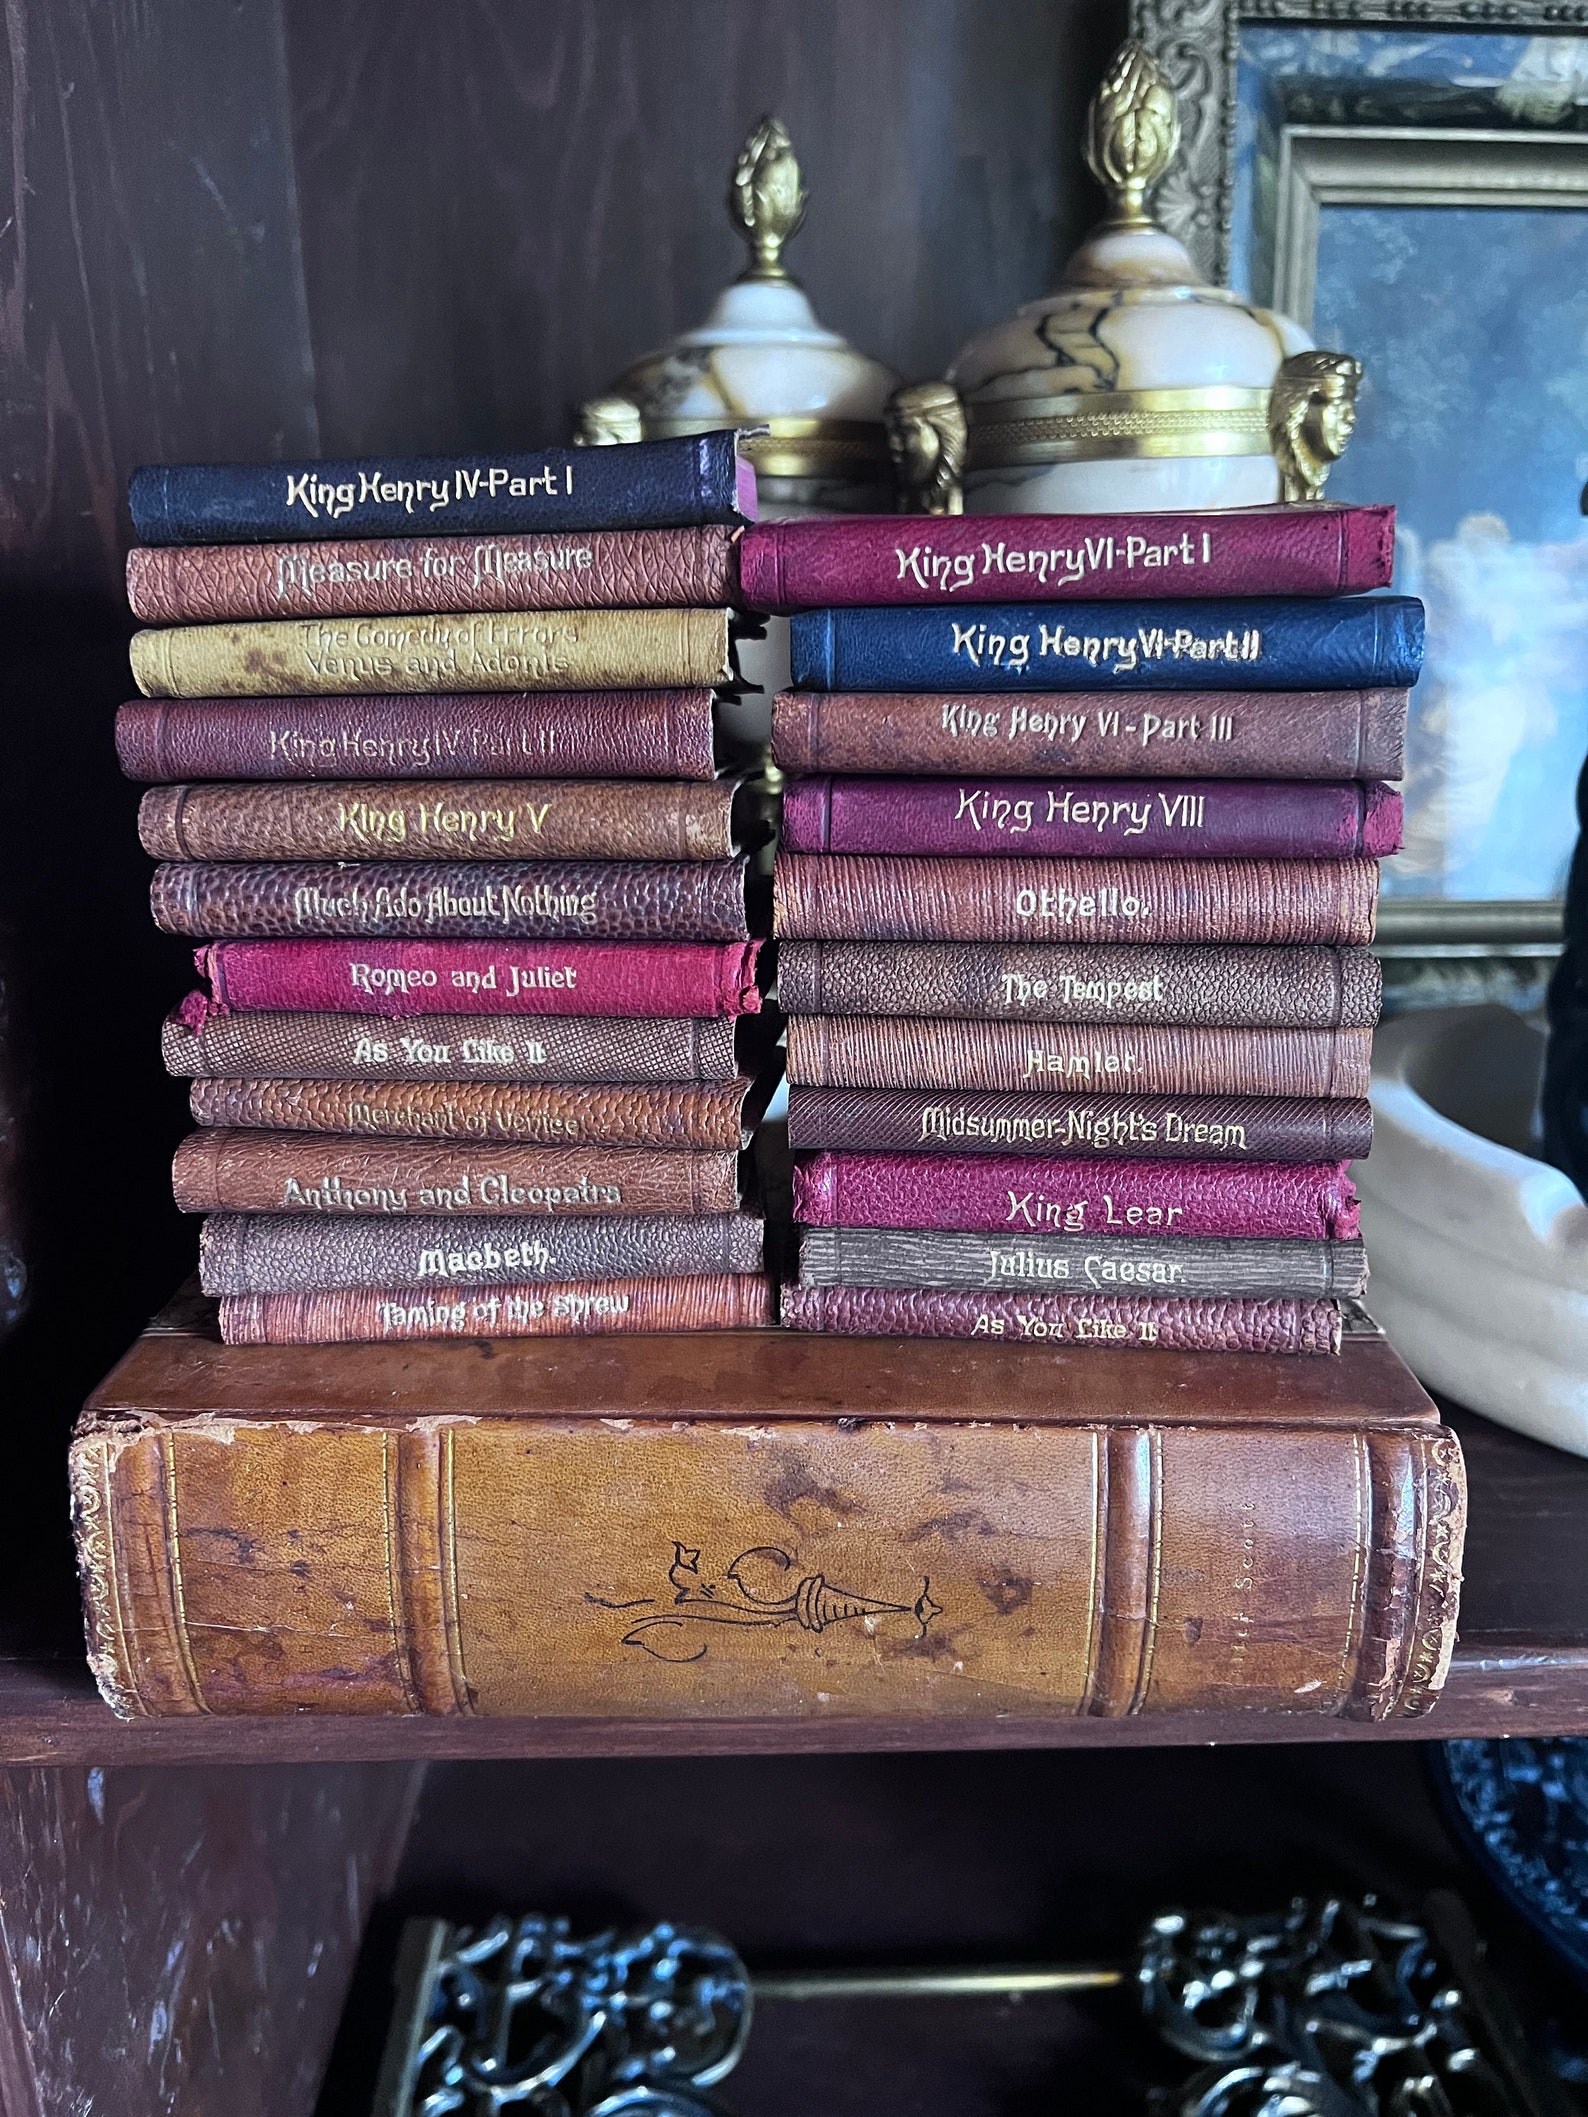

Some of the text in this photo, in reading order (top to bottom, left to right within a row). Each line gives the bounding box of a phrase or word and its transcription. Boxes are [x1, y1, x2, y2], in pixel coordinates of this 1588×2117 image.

[286, 473, 355, 519] King
[357, 472, 450, 514] Henry
[276, 544, 594, 602] Measure for Measure
[896, 546, 975, 593] King
[981, 542, 1086, 587] Henry
[300, 624, 350, 654] The
[354, 622, 452, 650] Comedy
[457, 620, 484, 647] of
[951, 623, 1031, 666] King
[1039, 624, 1140, 675] Henry
[304, 650, 395, 681] Venus
[404, 649, 457, 679] and
[941, 704, 1000, 737] King
[1008, 705, 1088, 742] Henry
[1098, 710, 1121, 738] VI
[1142, 712, 1201, 747] Part
[1210, 716, 1235, 741] III
[270, 729, 337, 777] King
[341, 726, 432, 767] Henry
[435, 729, 461, 756] IV
[337, 802, 552, 843] King Henry V
[955, 788, 1205, 836] King Henry VIII
[294, 884, 599, 926] Much Ado About Nothing
[349, 962, 578, 997] Romeo and Juliet
[1001, 973, 1164, 1009] The Tempest
[351, 1037, 548, 1065] As You Like It
[351, 1103, 580, 1137] Merchant of Venice
[1164, 1111, 1248, 1151] Dream
[284, 1174, 622, 1213] Anthony and Cleopatra
[1005, 1190, 1184, 1232] King Lear
[985, 1250, 1070, 1284] Julius
[376, 1299, 466, 1332] Taming
[474, 1300, 502, 1322] of
[507, 1297, 545, 1321] the
[970, 1313, 1160, 1342] As You Like It
